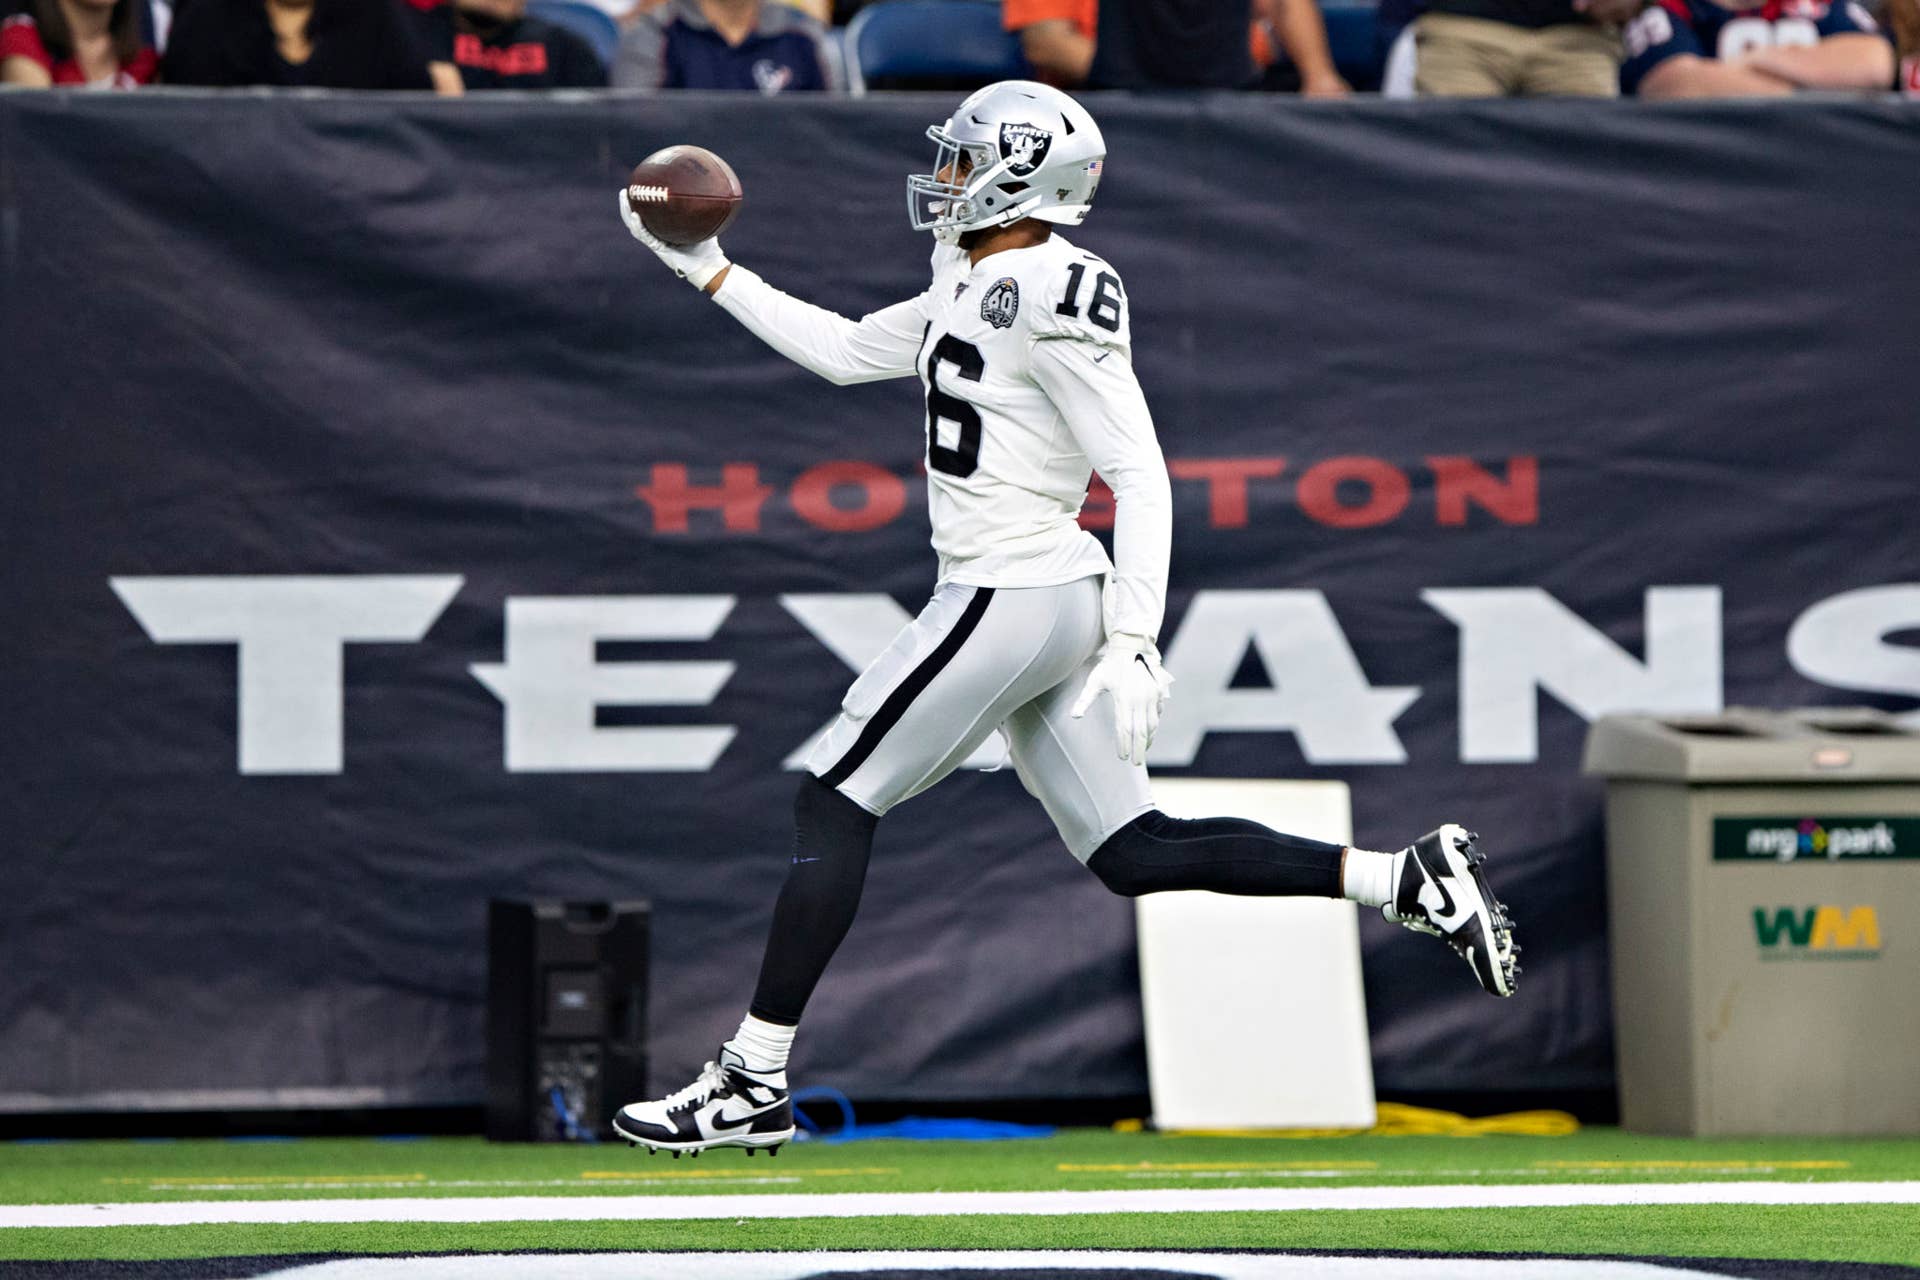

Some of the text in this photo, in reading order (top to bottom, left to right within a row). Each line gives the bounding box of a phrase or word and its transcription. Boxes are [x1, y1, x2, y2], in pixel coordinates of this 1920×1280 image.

[988, 287, 1013, 314] 60
[1056, 262, 1122, 333] 16
[916, 320, 985, 478] 6
[636, 456, 1539, 534] HOTON
[1746, 822, 1895, 862] nrg park
[1753, 905, 1881, 949] WM
